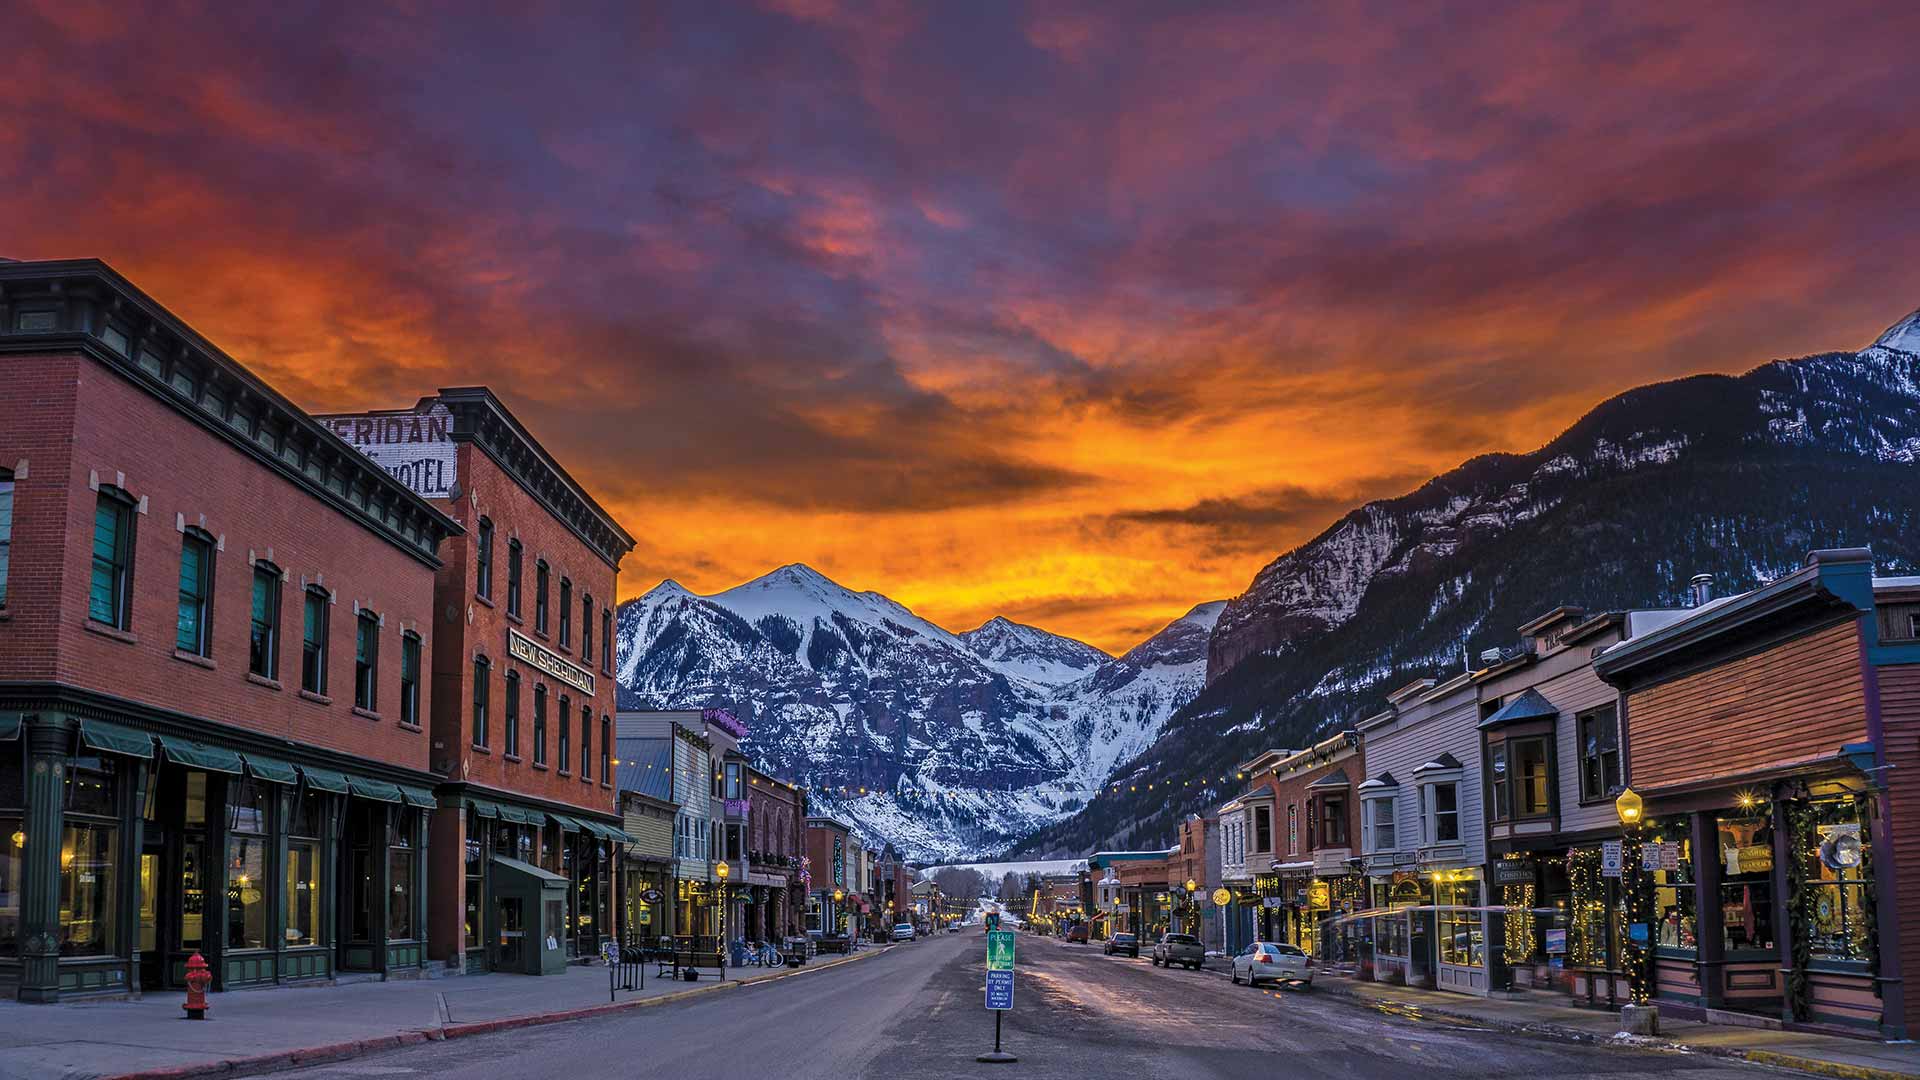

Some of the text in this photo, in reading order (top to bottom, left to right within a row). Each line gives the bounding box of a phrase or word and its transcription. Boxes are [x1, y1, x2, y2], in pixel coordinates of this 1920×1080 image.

[325, 416, 447, 445] ERIDAN
[510, 634, 593, 693] NEW SHERIDAN
[990, 934, 1012, 942] PLEASE
